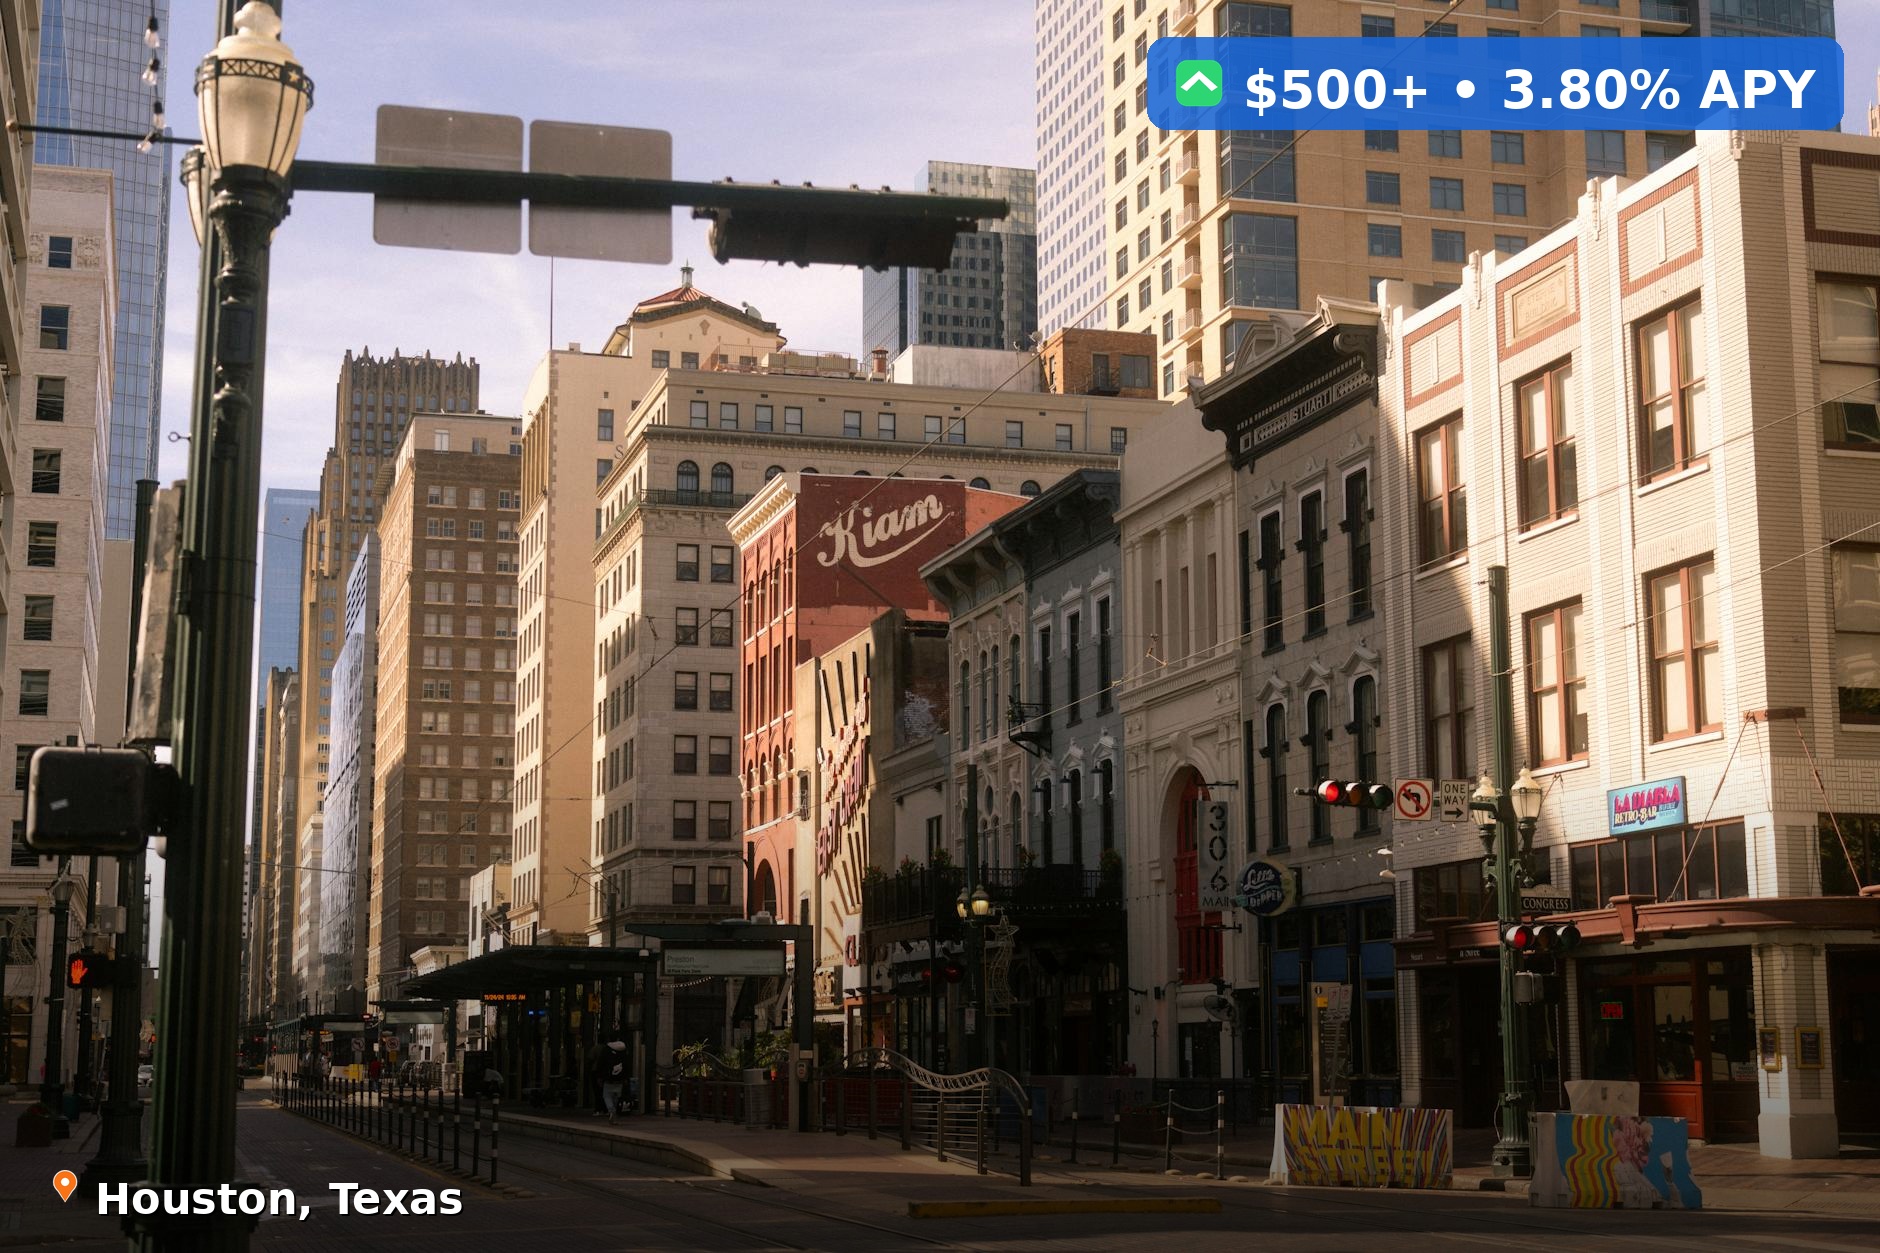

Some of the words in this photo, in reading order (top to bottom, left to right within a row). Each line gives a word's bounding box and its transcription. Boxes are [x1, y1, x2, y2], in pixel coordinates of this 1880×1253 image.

[1292, 389, 1330, 421] STUART
[817, 494, 953, 568] Kiam
[1444, 783, 1466, 794] ONE
[1614, 793, 1631, 813] LA
[1632, 783, 1680, 811] DIABLA
[1443, 795, 1466, 805] WAY
[1208, 805, 1229, 892] 306
[1522, 897, 1569, 910] CONGRESS
[667, 954, 695, 965] Preston
[1600, 1003, 1623, 1018] OPEN
[1285, 1107, 1403, 1148] MAIN
